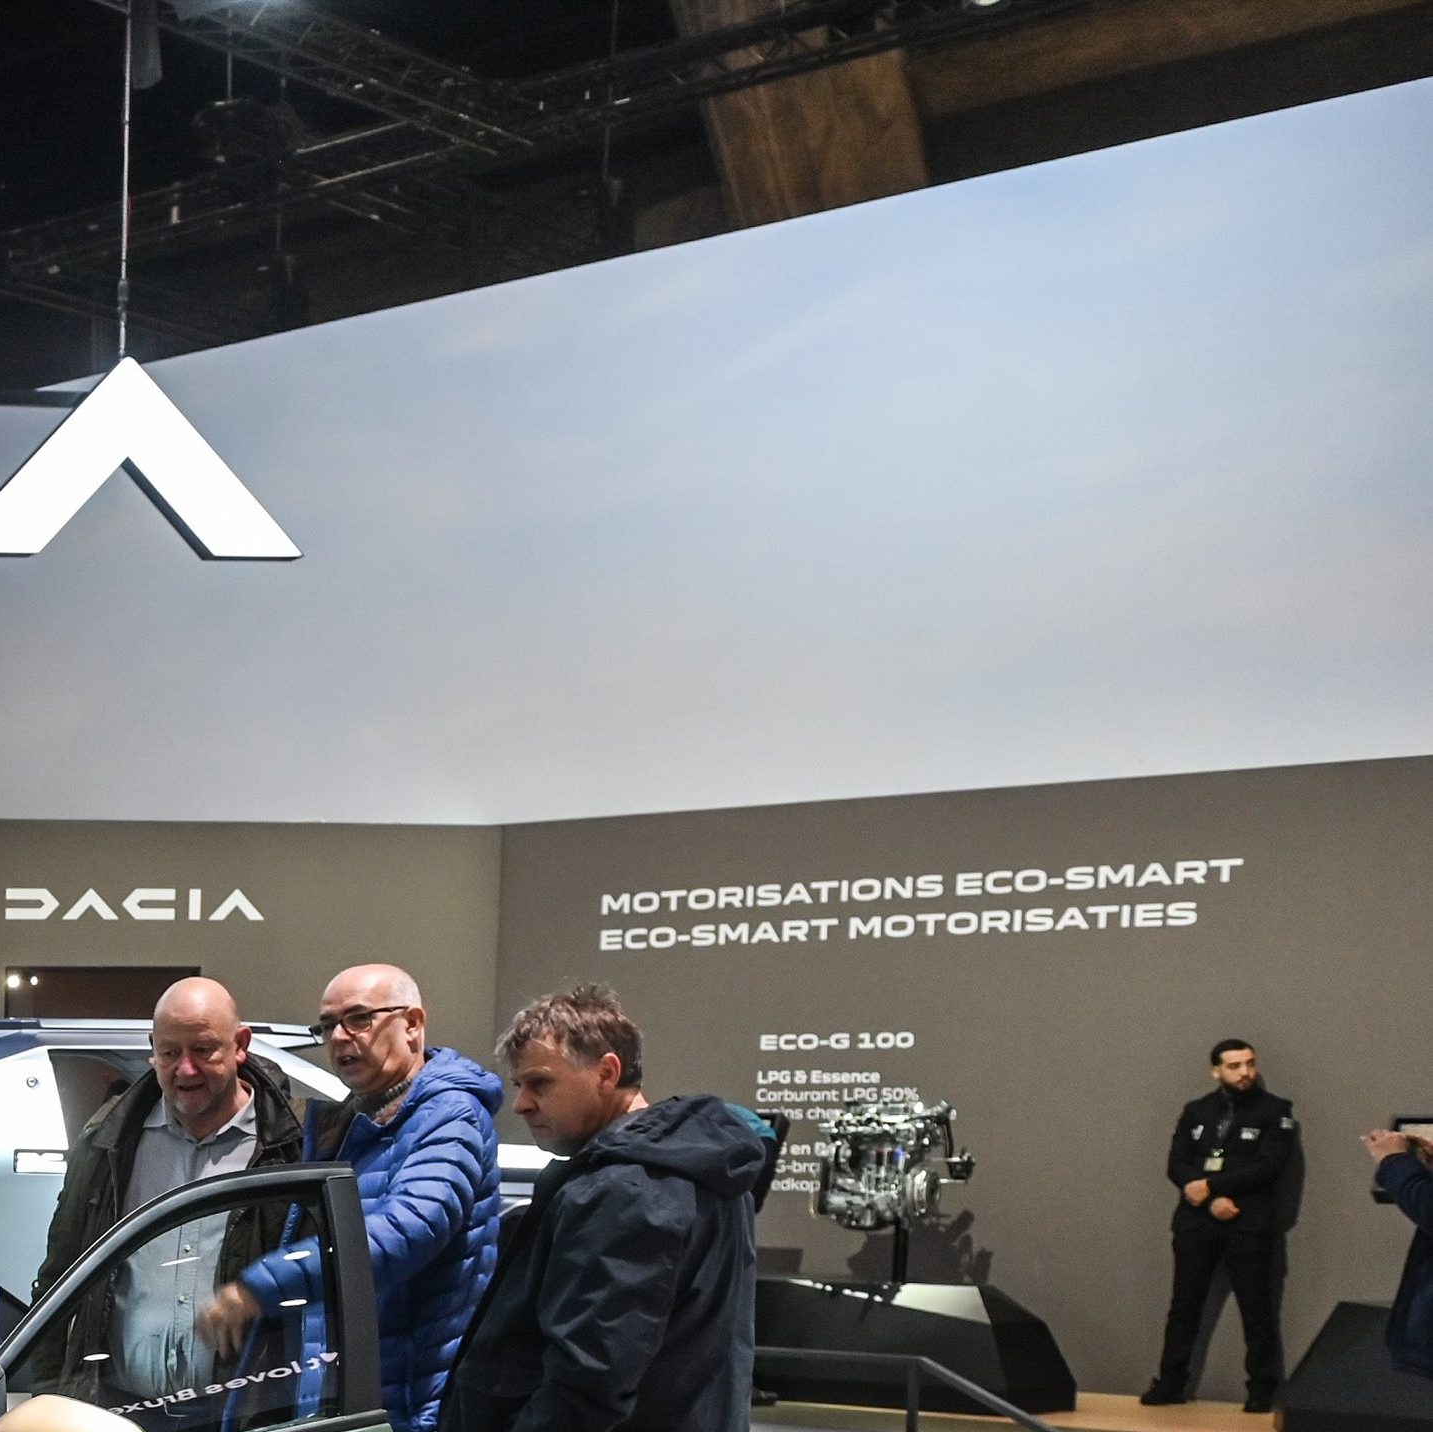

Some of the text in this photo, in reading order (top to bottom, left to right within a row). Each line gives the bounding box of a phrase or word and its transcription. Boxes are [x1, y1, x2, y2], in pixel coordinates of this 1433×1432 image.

[600, 858, 1244, 916] MOTORISATIONS ECO-SMART
[5, 888, 265, 921] DACIA
[599, 901, 1198, 951] ECO-SMART MOTORISATIES
[760, 1032, 915, 1051] ECO-G 100
[757, 1070, 881, 1084] LPG & Essence
[756, 1087, 919, 1102] Carburant LPG 50%
[789, 1143, 811, 1156] en
[771, 1178, 821, 1192] edkop
